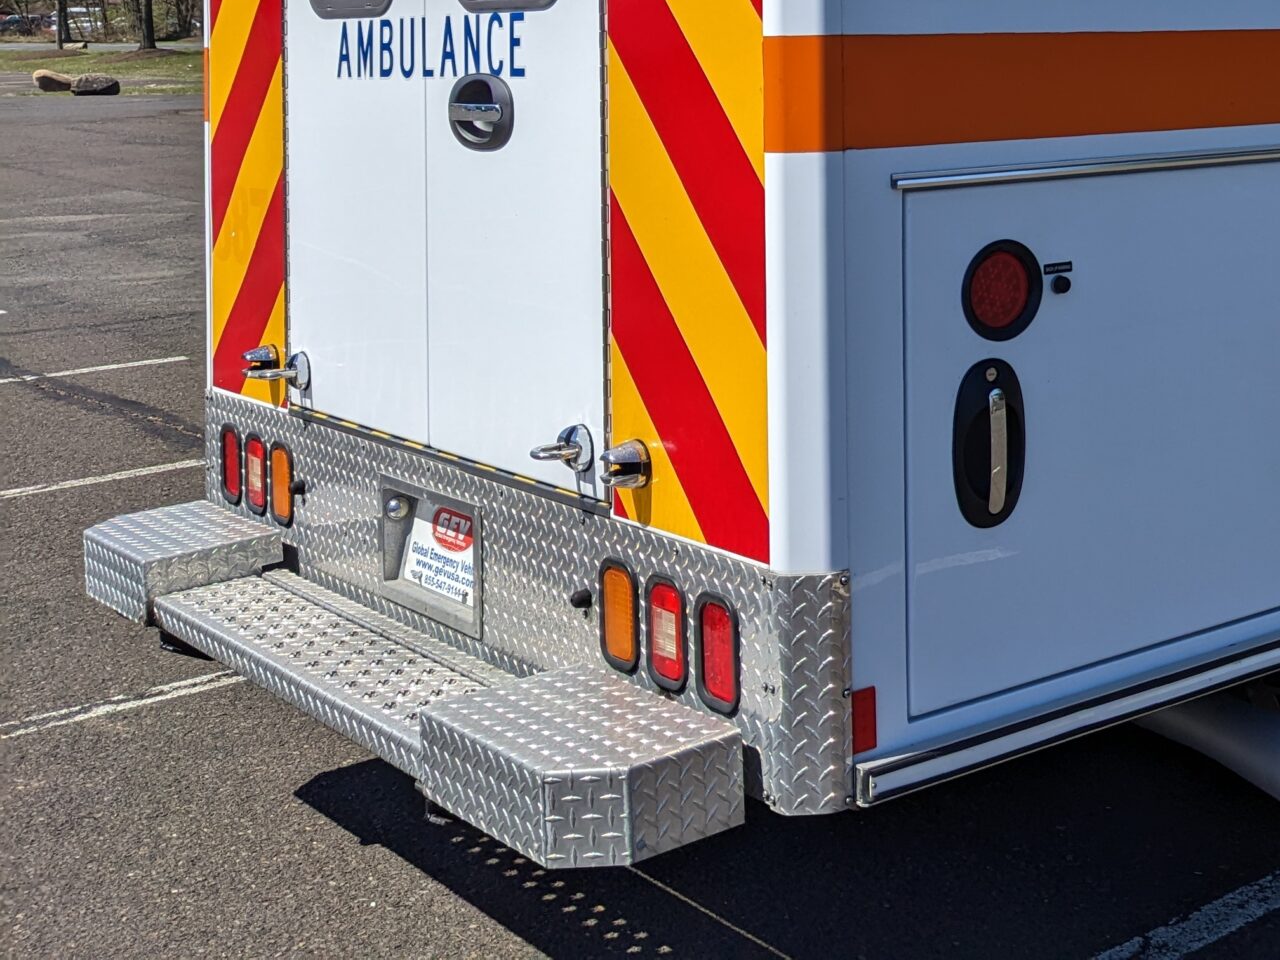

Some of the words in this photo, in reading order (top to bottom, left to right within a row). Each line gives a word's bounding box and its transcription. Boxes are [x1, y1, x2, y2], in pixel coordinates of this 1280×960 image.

[336, 11, 527, 79] AMBULANCE
[436, 512, 471, 541] GEV
[411, 541, 429, 558] Global
[430, 548, 460, 573] Emergency
